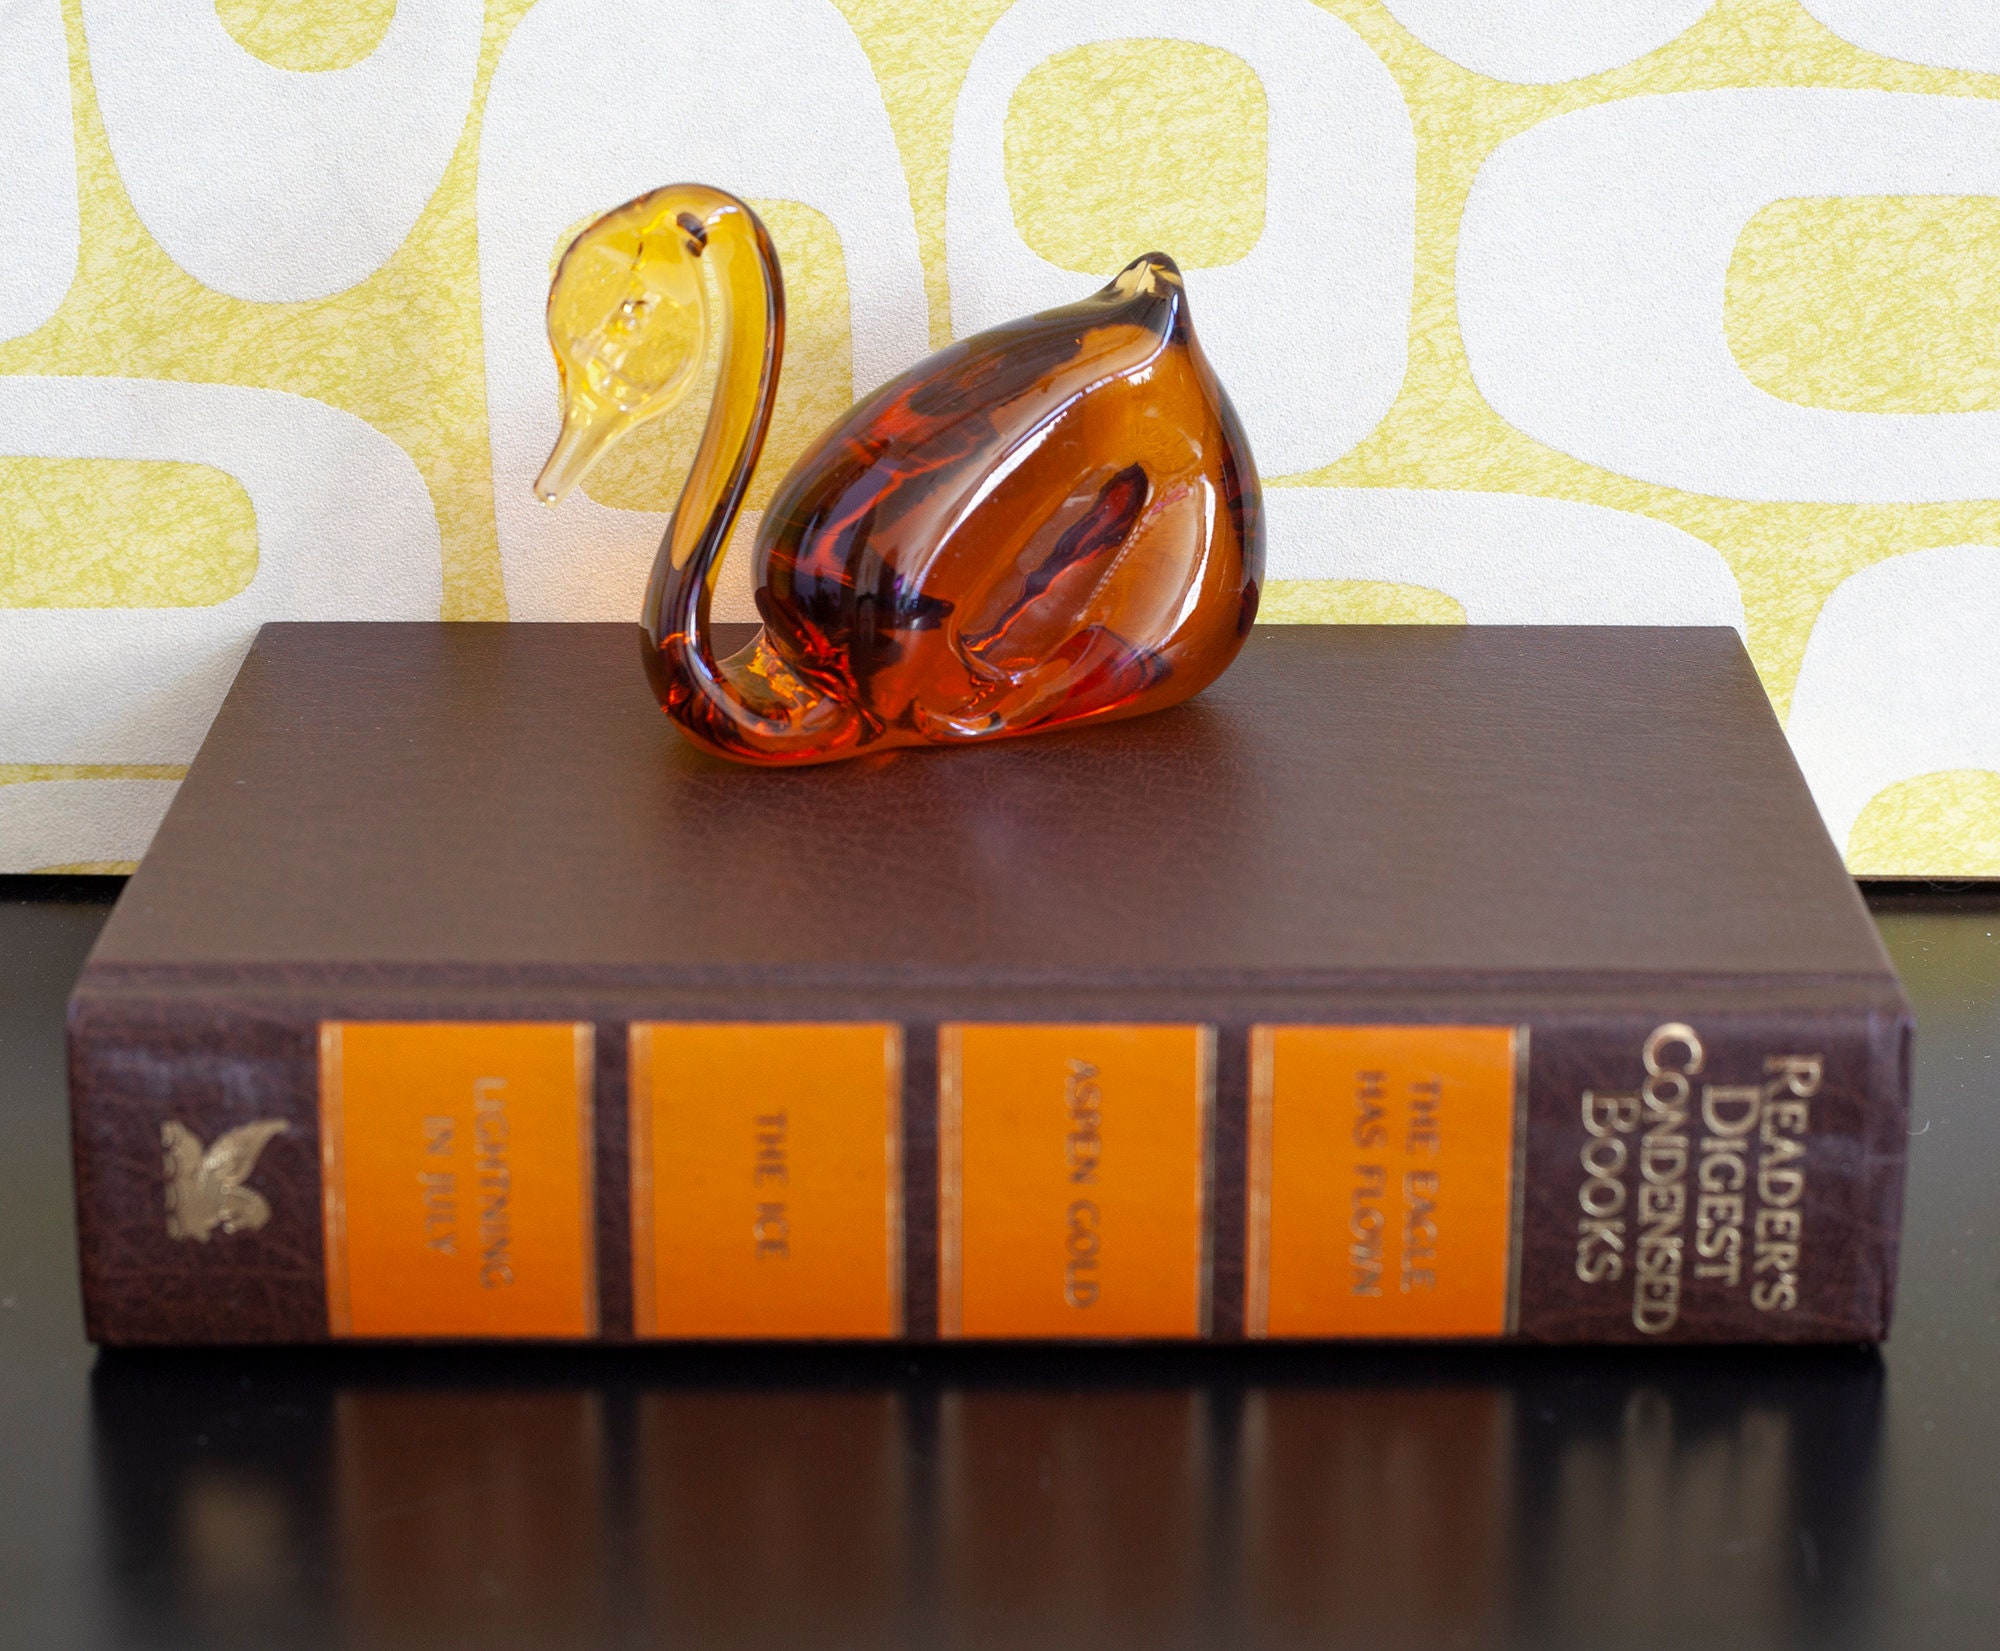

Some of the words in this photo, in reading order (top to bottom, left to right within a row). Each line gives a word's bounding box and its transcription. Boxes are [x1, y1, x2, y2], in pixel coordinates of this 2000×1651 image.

[423, 1116, 454, 1156] IN
[757, 1106, 788, 1186] THE
[1066, 1058, 1101, 1185] ASPEN
[1355, 1070, 1386, 1148] HAS
[1409, 1073, 1440, 1157] THE
[418, 1172, 456, 1256] JULY
[755, 1202, 788, 1260] ICE
[1351, 1165, 1385, 1297] FLOWN
[1402, 1169, 1439, 1293] EAGLE
[1578, 1089, 1641, 1284] BOOKS
[1634, 1022, 1703, 1335] CONDENSED
[1696, 1084, 1760, 1288] DIGEST
[1753, 1054, 1822, 1312] READER'S
[1066, 1200, 1100, 1308] GOLD
